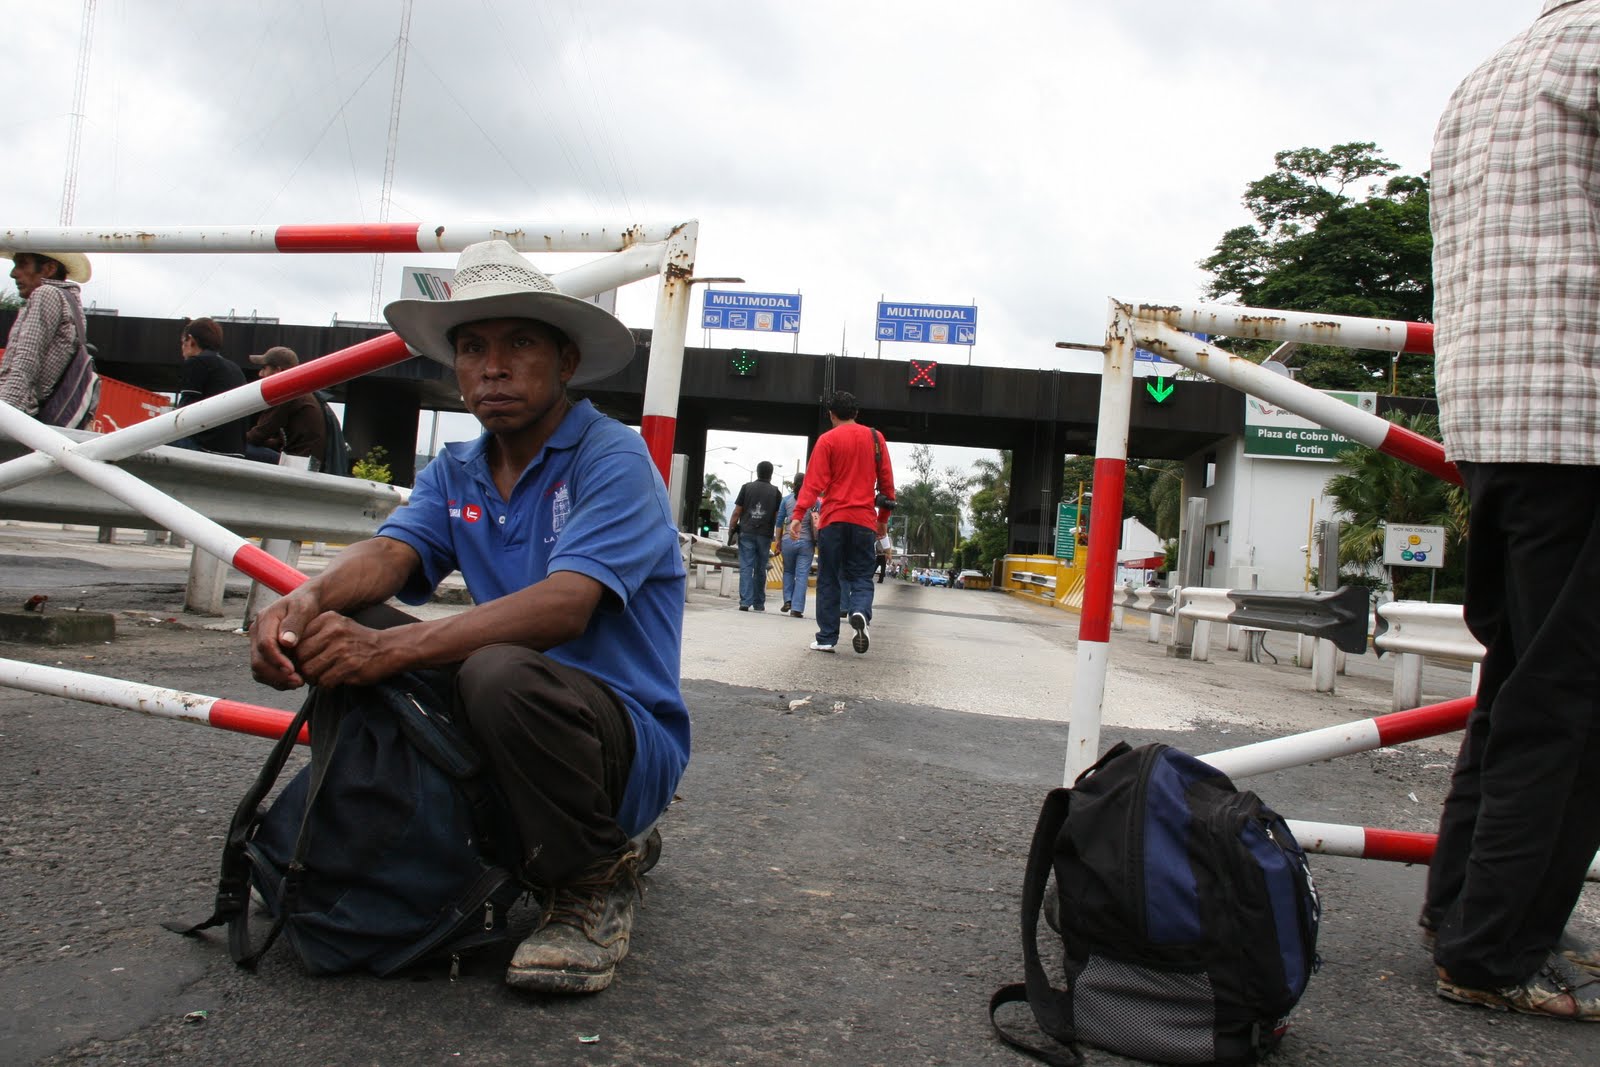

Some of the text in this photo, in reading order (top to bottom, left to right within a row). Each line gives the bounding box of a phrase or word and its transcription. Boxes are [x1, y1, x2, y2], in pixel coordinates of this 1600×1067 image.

[712, 294, 792, 308] MULTIMODAL
[886, 306, 967, 320] MULTIMODAL
[1257, 428, 1348, 442] Plaza de Cobro No.
